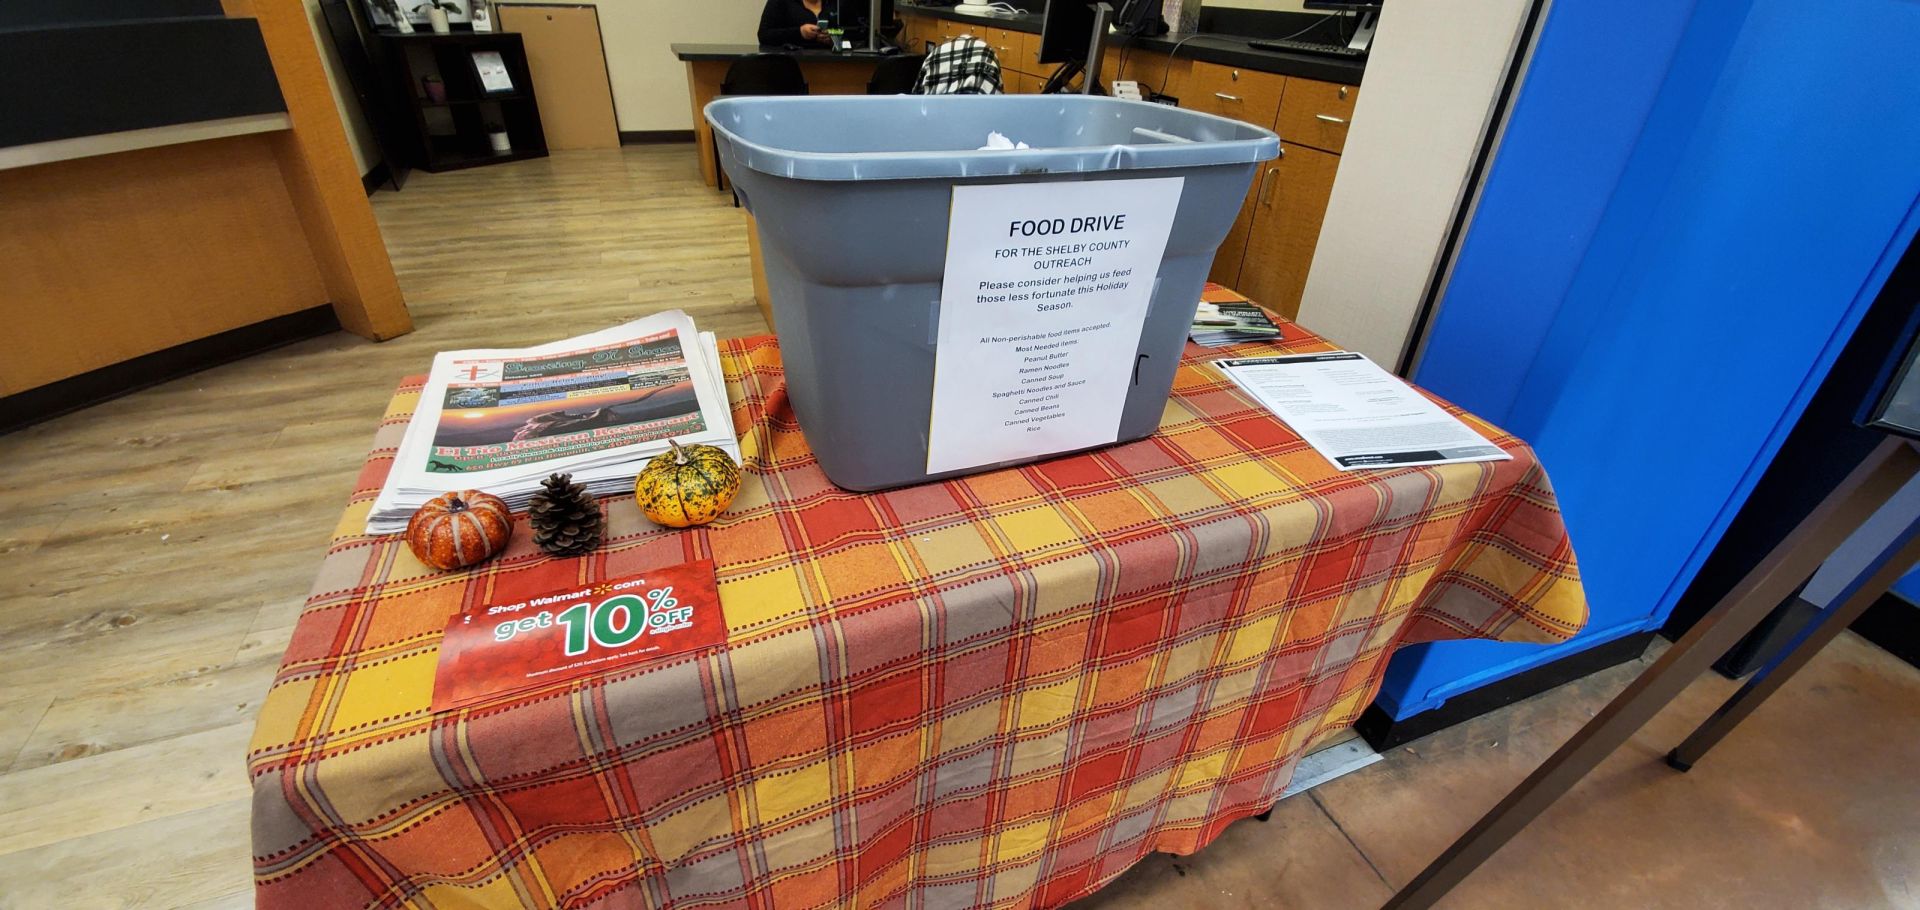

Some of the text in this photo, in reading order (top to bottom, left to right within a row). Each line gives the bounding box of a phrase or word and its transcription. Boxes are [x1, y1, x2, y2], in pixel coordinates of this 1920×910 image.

[1009, 214, 1126, 237] FOOD DRIVE
[995, 239, 1131, 259] FOR THE SHELBY COUNTY
[1033, 256, 1092, 270] OUTREACH
[979, 267, 1132, 290] Please consider helping us feed
[976, 280, 1129, 304] those less fortunate this Holiday
[1036, 301, 1073, 312] Season.
[980, 321, 1112, 344] All Non-perishable food items accepted.
[1015, 344, 1033, 353] Most
[1034, 342, 1060, 351] Needed
[1023, 351, 1069, 363] Peanut Butter
[1018, 361, 1070, 374] Ramen Noodles
[1021, 372, 1065, 385] Canned Soup
[992, 378, 1087, 399] Spaghetti Noodles and Sauce
[1018, 393, 1060, 405] Canned Chili
[1014, 402, 1060, 416] Canned Beans
[1004, 411, 1066, 427] Canned Vegetables
[434, 446, 461, 457] El
[466, 445, 503, 456] Tio
[506, 431, 590, 453] Mexican
[593, 410, 700, 438] Restaurant
[1026, 425, 1041, 433] Rice
[488, 578, 646, 616] Shop Walmart com
[495, 610, 552, 642] get
[556, 593, 649, 657] 10
[649, 605, 694, 627] OFF
